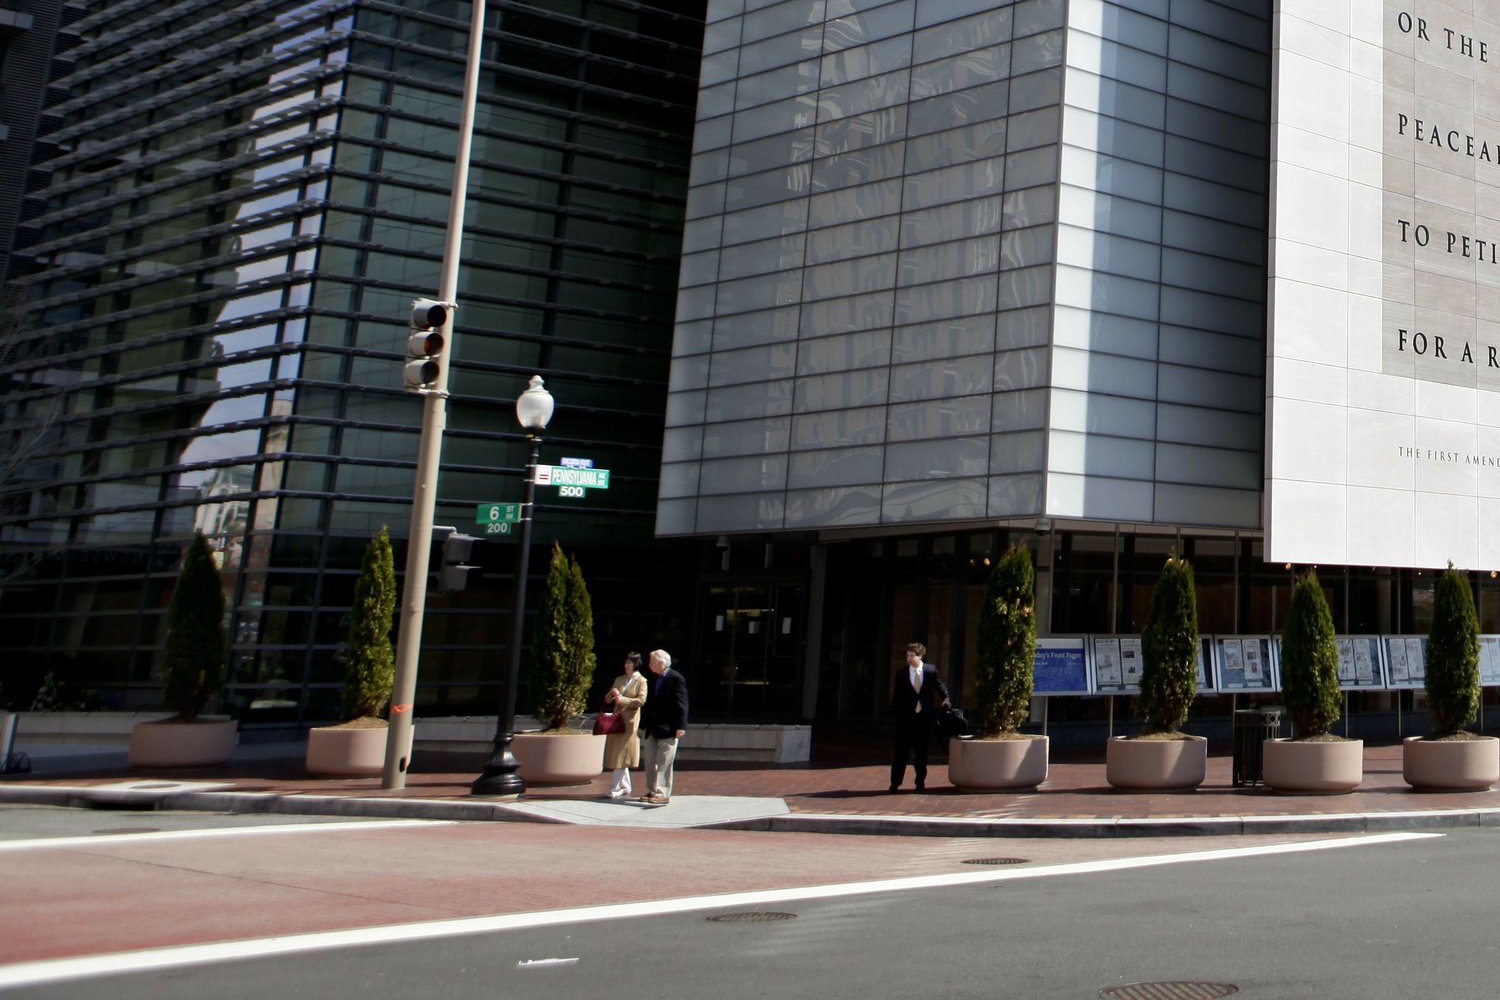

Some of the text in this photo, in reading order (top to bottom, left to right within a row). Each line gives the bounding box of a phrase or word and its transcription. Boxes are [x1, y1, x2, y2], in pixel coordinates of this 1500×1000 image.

[1398, 12, 1430, 41] OR
[1444, 28, 1487, 63] THE
[1398, 220, 1429, 247] TO
[1398, 329, 1447, 359] FOR
[1461, 342, 1474, 364] A
[1399, 446, 1420, 458] THE
[1428, 450, 1458, 462] FIRST
[552, 469, 596, 485] PENNSYLVANIA
[560, 487, 583, 496] 500
[490, 507, 499, 520] 6
[488, 524, 508, 533] 200
